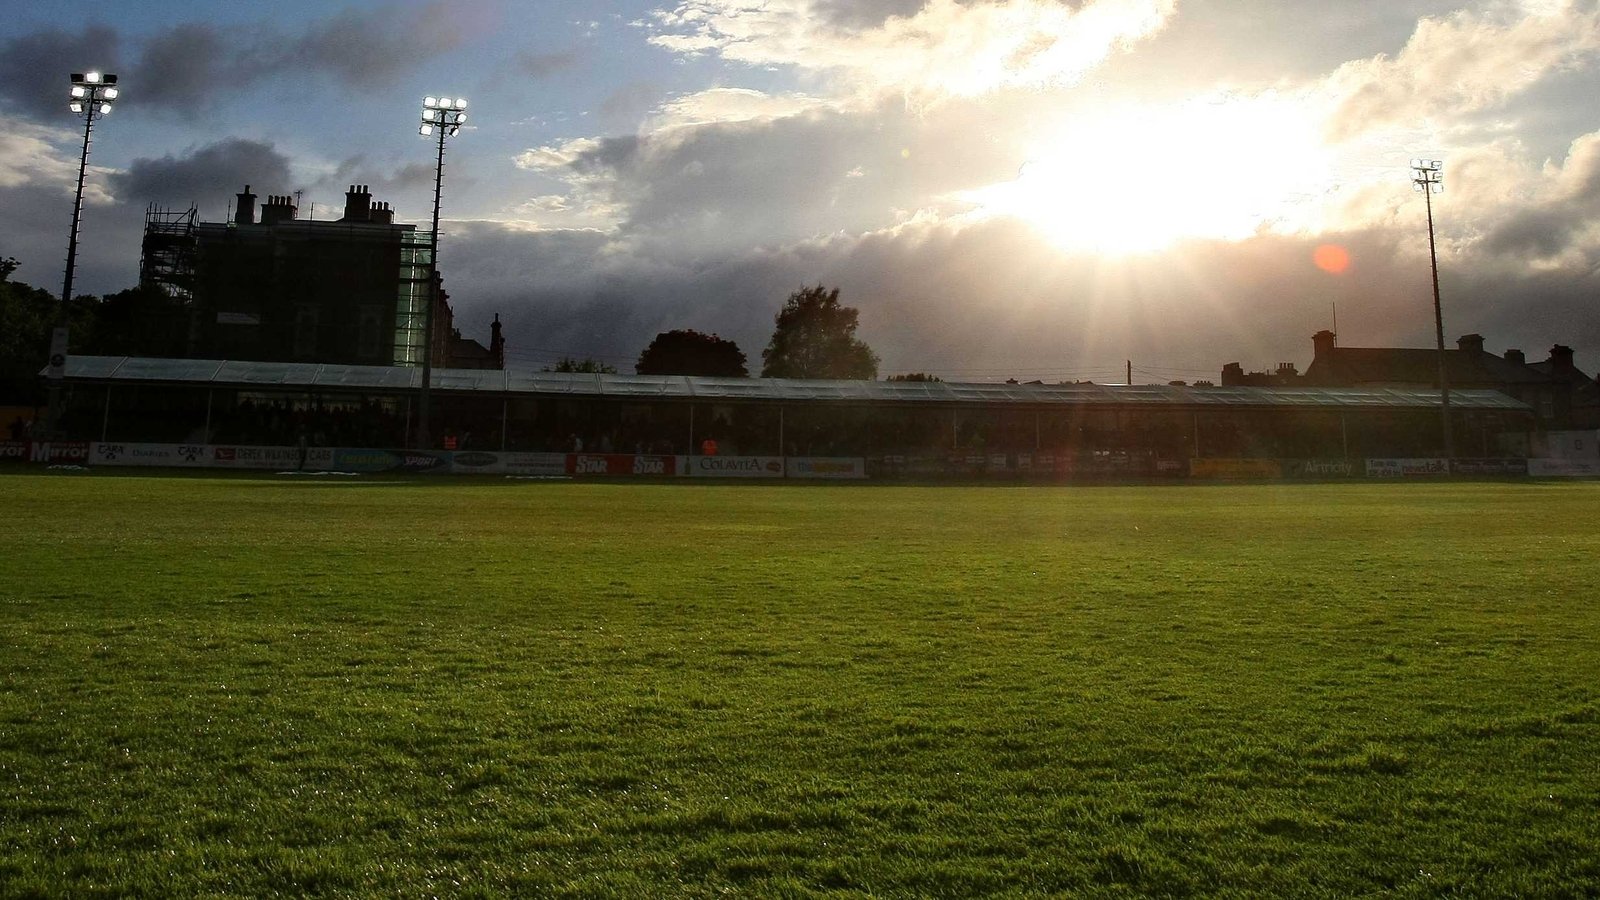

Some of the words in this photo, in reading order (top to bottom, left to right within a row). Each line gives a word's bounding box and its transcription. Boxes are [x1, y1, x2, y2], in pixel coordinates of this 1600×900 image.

[30, 441, 88, 462] Mirror
[264, 449, 306, 460] WILKINSO
[309, 450, 332, 461] CARS
[404, 456, 437, 466] SPORT
[1305, 459, 1352, 476] Airtricity
